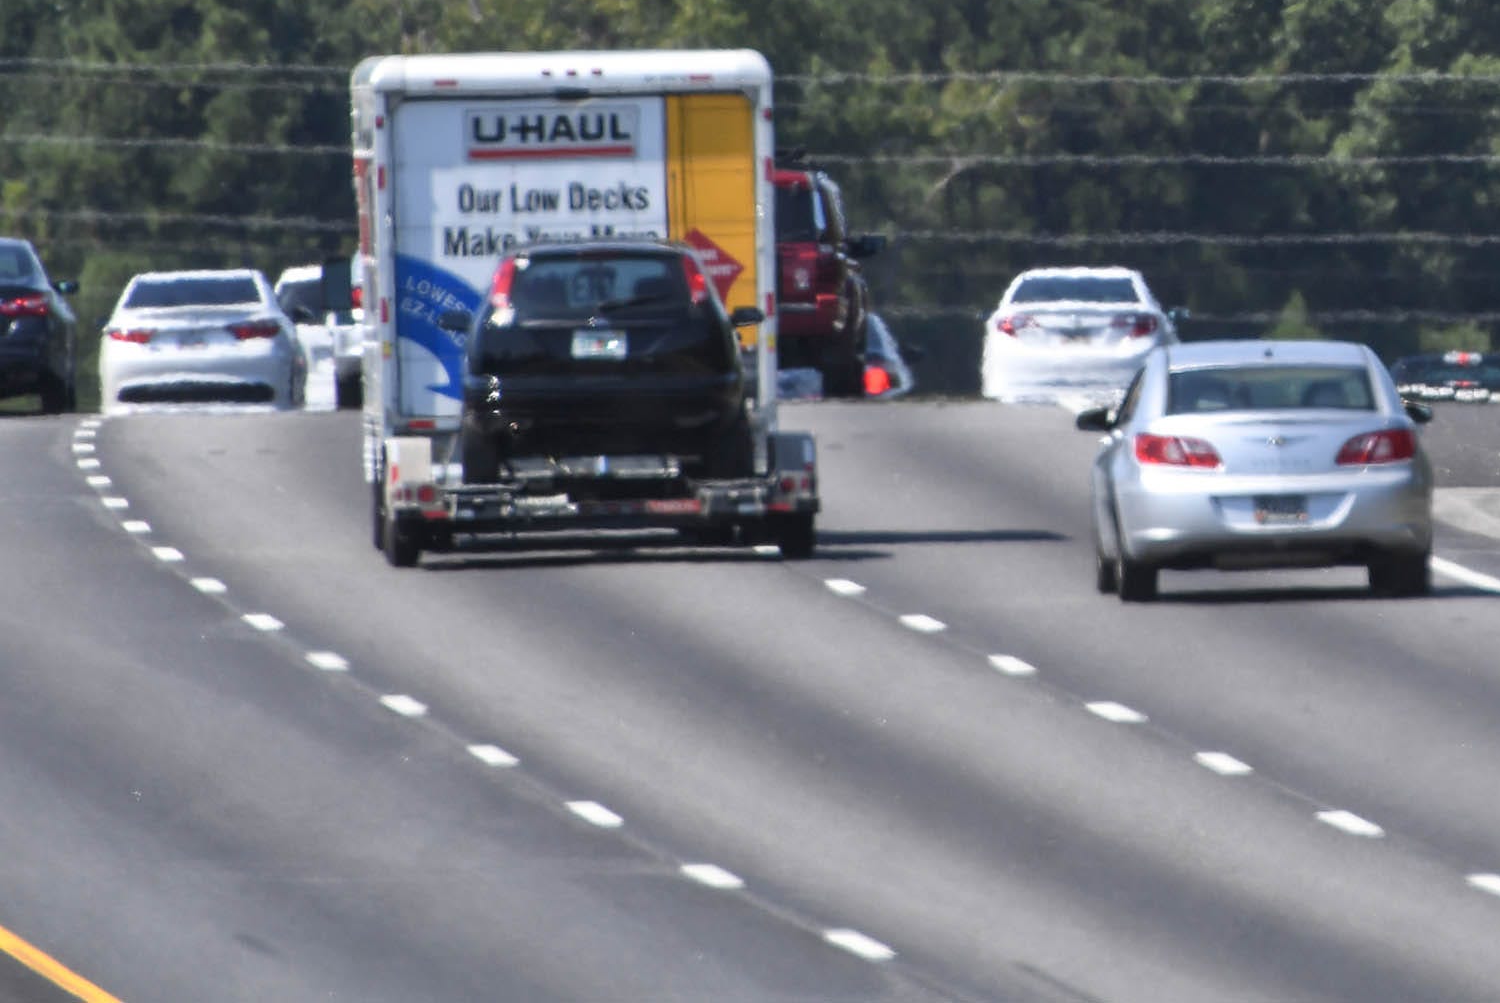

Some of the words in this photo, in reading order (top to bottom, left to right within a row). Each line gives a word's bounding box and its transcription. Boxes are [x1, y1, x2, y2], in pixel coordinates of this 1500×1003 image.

[473, 113, 631, 143] U-HAUL
[458, 182, 502, 213] Our
[510, 182, 560, 213] Low
[568, 180, 650, 211] Decks
